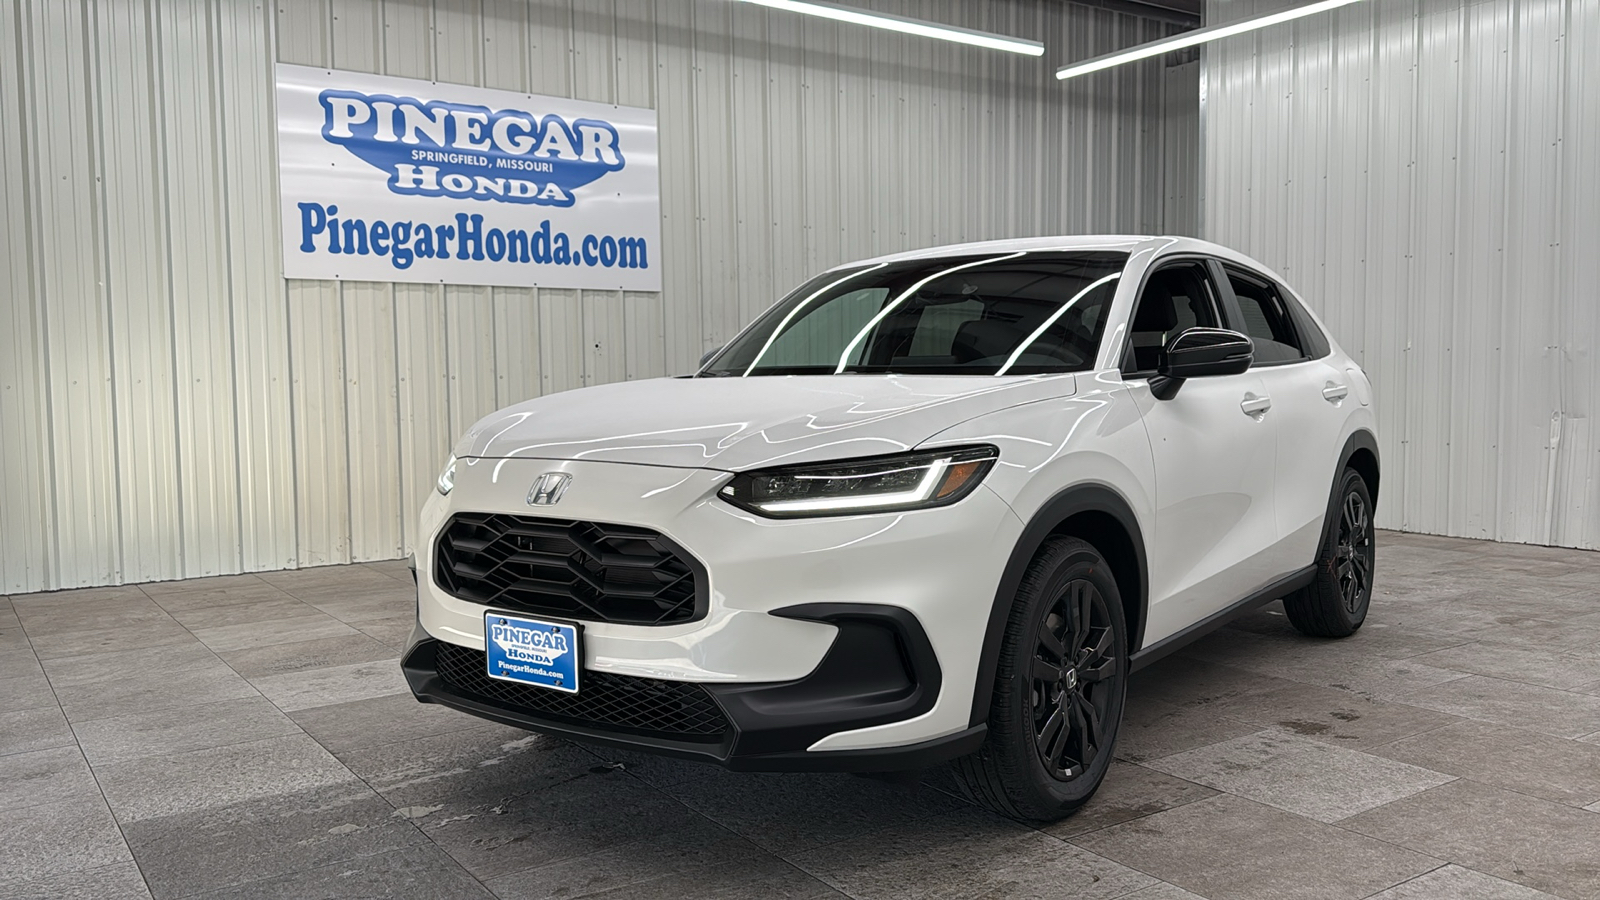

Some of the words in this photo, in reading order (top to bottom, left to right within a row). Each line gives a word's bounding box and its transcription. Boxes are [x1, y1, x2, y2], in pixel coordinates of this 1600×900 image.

[326, 96, 620, 165] PINEGAR
[411, 149, 493, 169] SPRINGFIELD,
[496, 158, 553, 173] MISSOURI
[394, 163, 570, 201] HONDA
[297, 202, 649, 270] PinegarHonda.com
[493, 626, 566, 651] PINEGAR
[507, 648, 552, 664] HONDA
[498, 660, 564, 679] PinegarHonda.com
